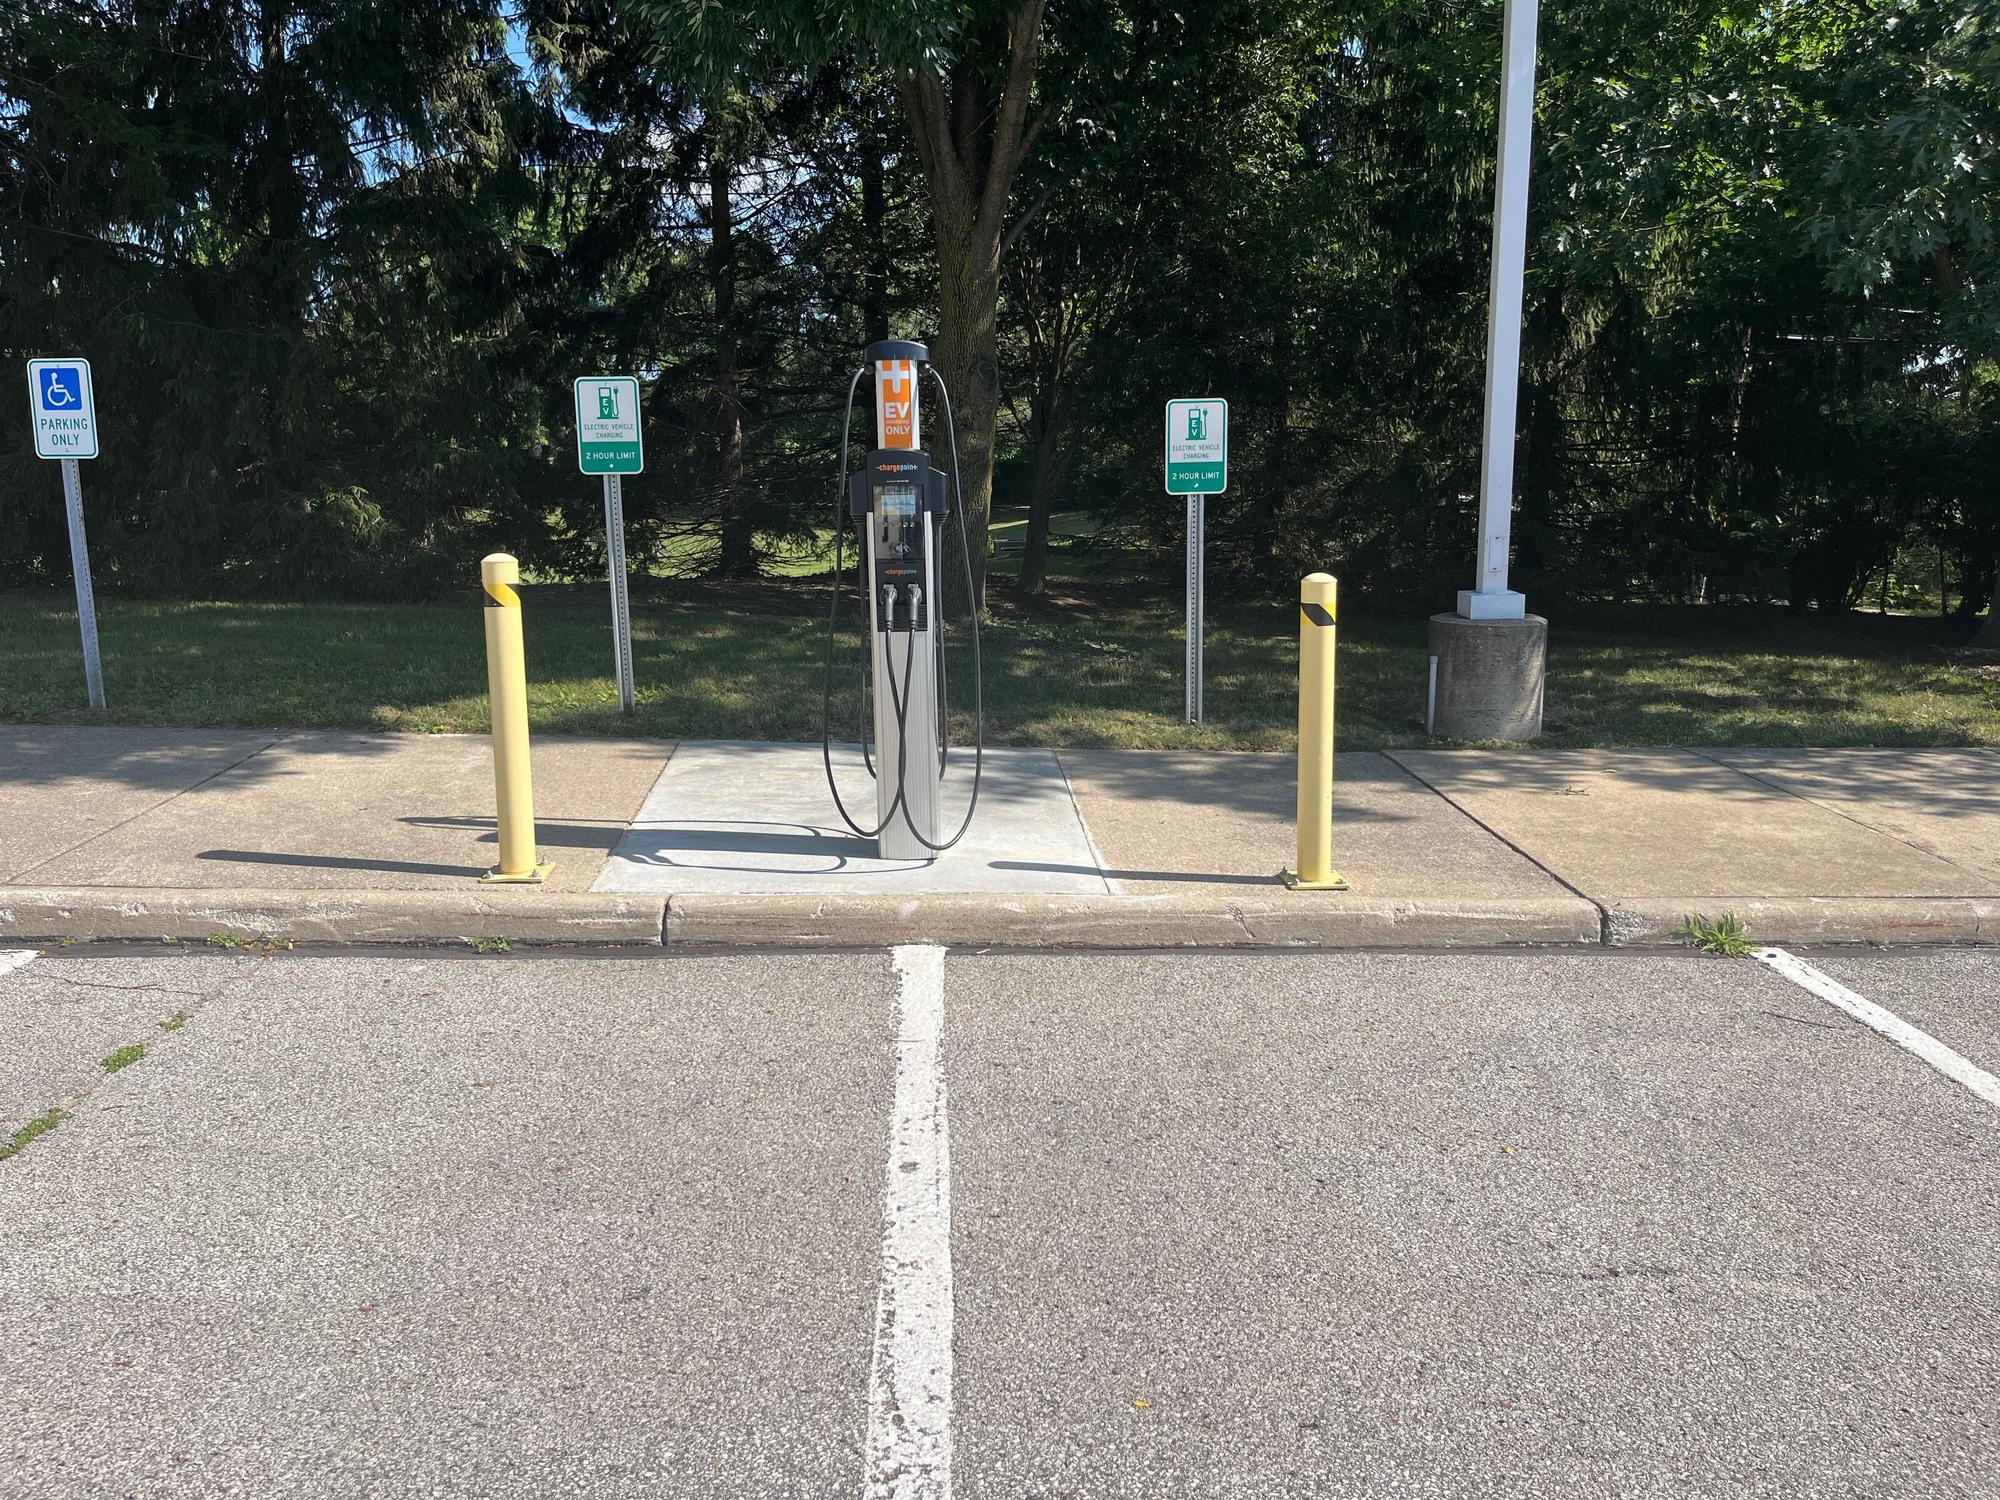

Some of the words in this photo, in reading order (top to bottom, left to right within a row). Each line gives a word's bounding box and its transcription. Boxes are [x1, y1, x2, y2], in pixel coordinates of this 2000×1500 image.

[885, 401, 910, 418] EV
[41, 418, 88, 430] PARKING
[584, 423, 609, 431] ELECTRIC
[885, 425, 910, 435] ONLY
[51, 433, 79, 445] ONLY
[585, 452, 591, 460] 2
[593, 452, 614, 460] HOUR
[616, 451, 636, 460] LIMIT
[1172, 472, 1178, 480] 2
[1179, 472, 1200, 480] HOUR
[1201, 471, 1220, 480] LIMIT
